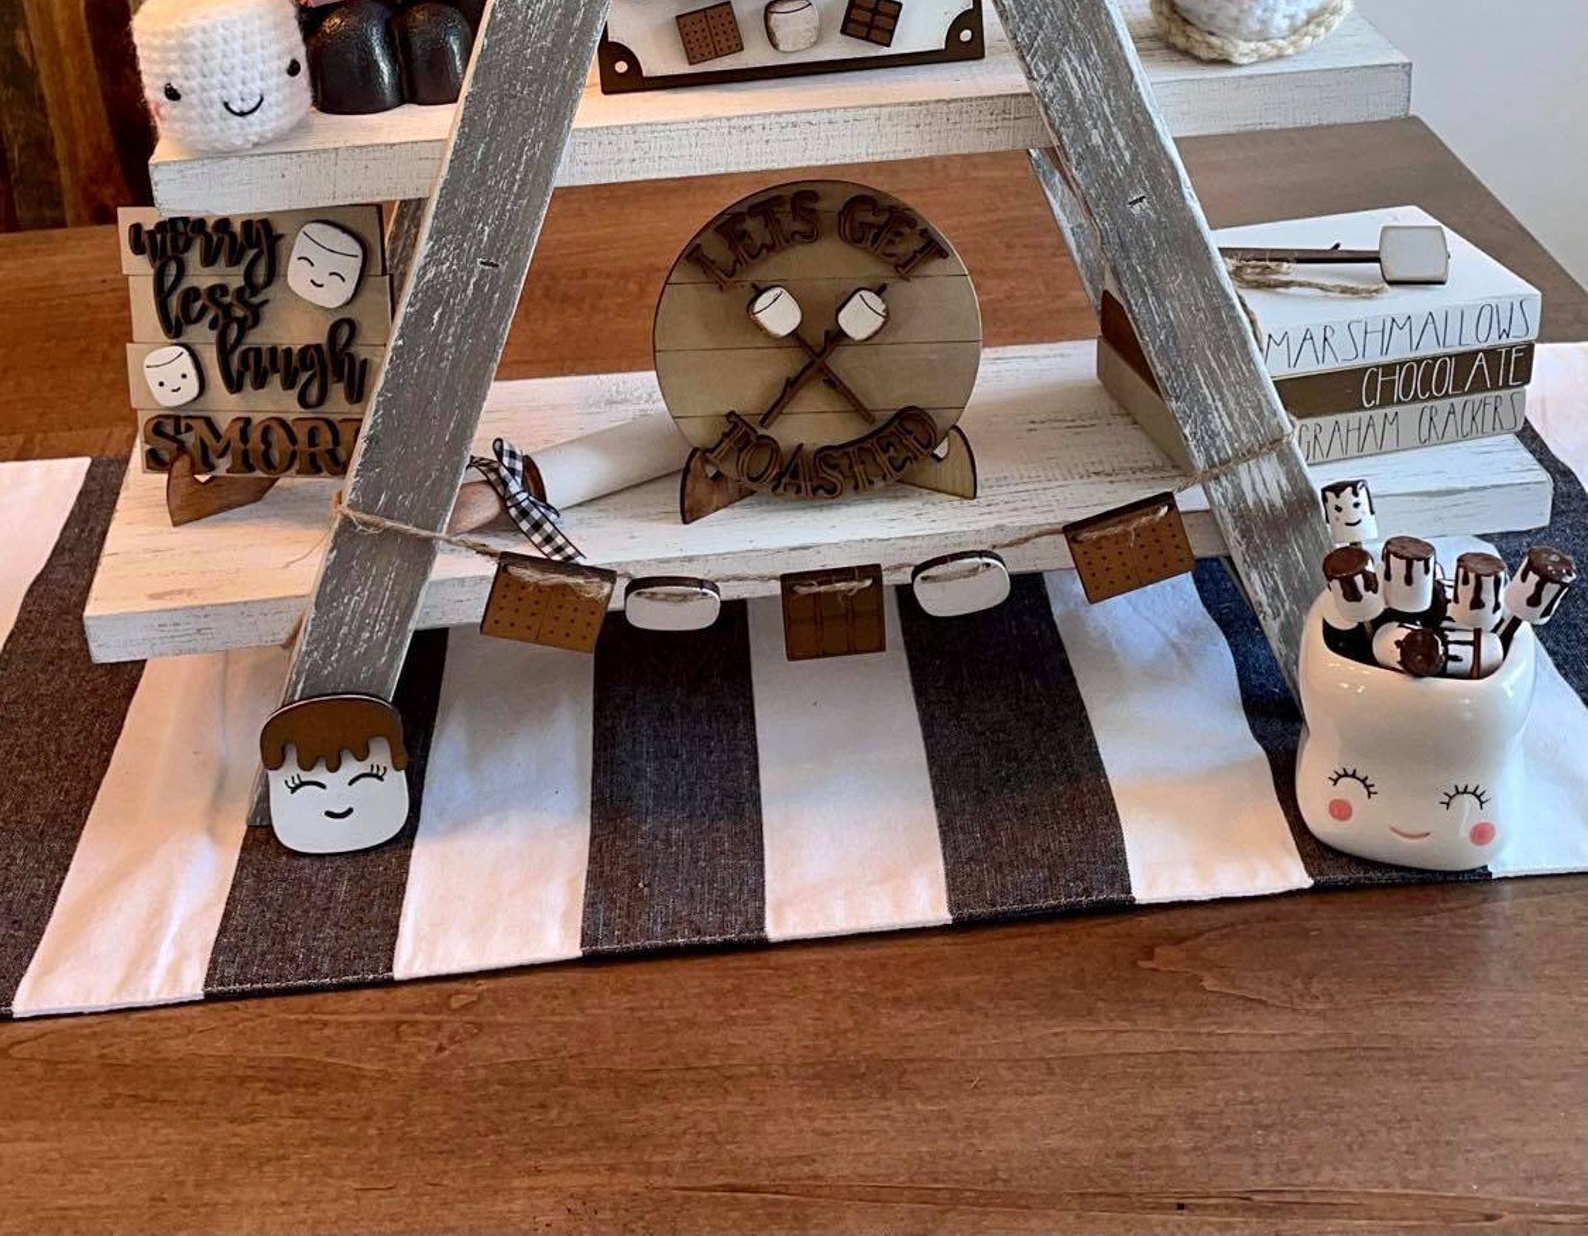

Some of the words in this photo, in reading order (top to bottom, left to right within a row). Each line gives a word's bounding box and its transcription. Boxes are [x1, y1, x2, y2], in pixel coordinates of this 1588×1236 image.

[128, 216, 286, 294] worry
[685, 189, 820, 290] LETS
[837, 194, 950, 282] GET
[153, 253, 270, 340] less
[1264, 299, 1531, 369] MARSHMALLOWS
[216, 317, 368, 410] laugh
[1361, 347, 1525, 408] CHOCOLATE
[703, 405, 938, 500] TOASTED
[1298, 410, 1400, 462] GRAHAM
[1417, 395, 1518, 444] CRACKERS
